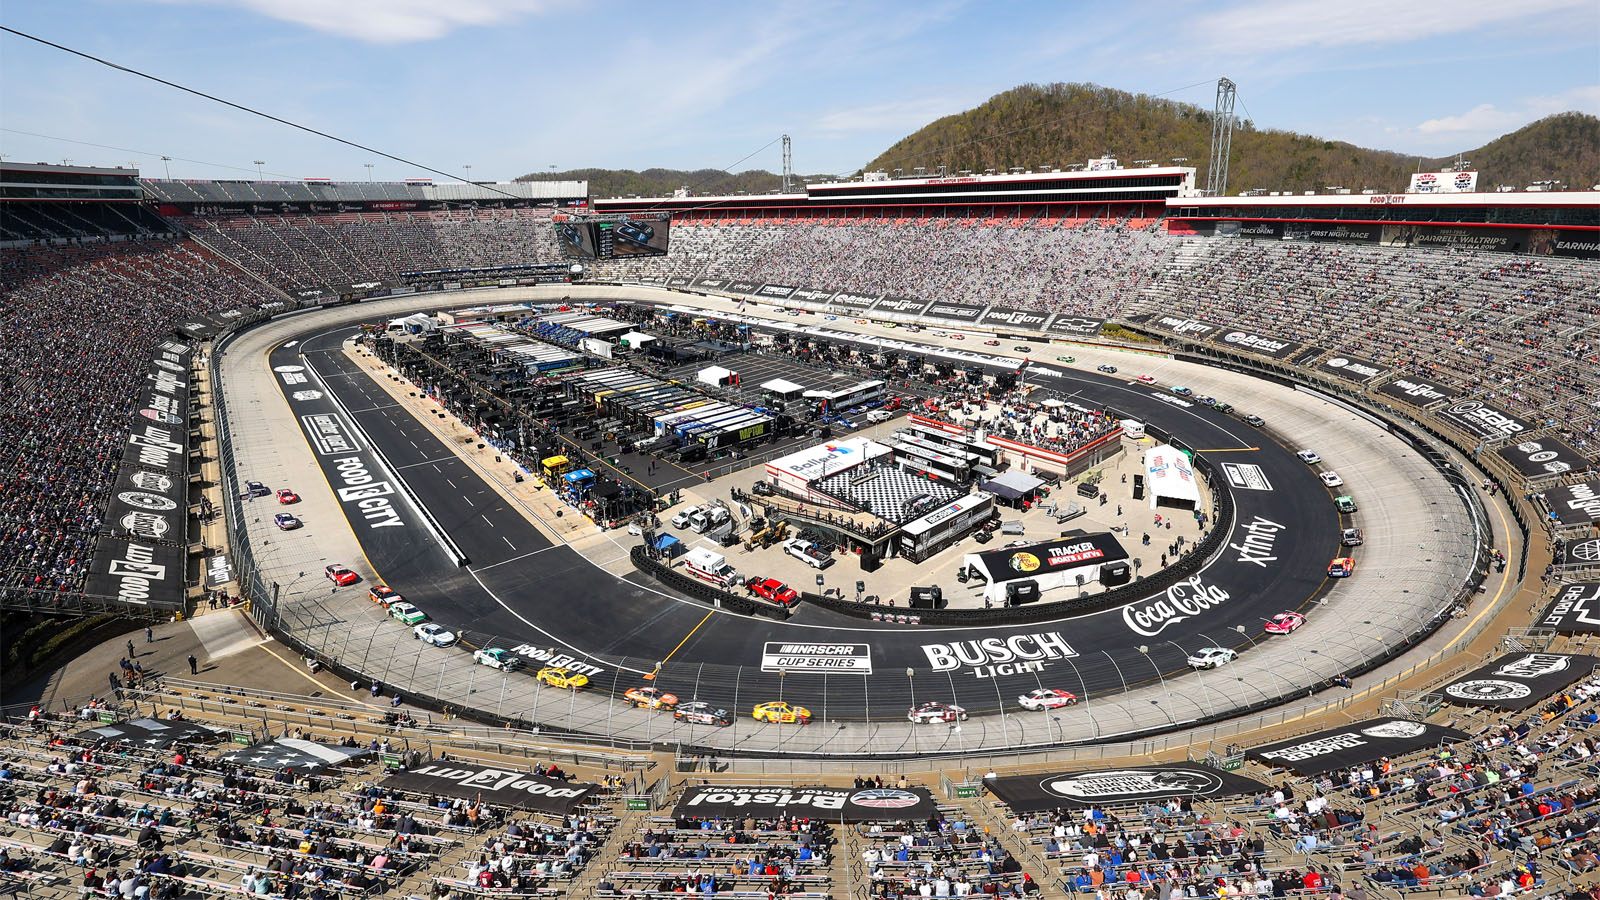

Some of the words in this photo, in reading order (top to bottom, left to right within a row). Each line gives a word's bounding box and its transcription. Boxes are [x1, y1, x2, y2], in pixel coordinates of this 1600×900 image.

[1418, 234, 1458, 243] DARRELL
[1459, 236, 1508, 245] WALTRIP'S
[846, 295, 876, 304] Bristol
[987, 312, 1008, 320] FOOD
[1022, 316, 1046, 324] CITY
[1052, 324, 1097, 334] CHEVROLET
[1192, 323, 1214, 333] CITY
[1244, 334, 1288, 350] Bristol
[1424, 389, 1446, 400] CITY
[1470, 408, 1524, 434] state
[144, 426, 171, 442] CITY
[739, 424, 764, 440] RAPTOR
[708, 436, 718, 448] 24
[139, 446, 169, 468] FOOD
[790, 453, 838, 472] Ballad
[334, 456, 372, 484] FOOD
[358, 498, 404, 528] CITY
[134, 512, 158, 536] BUSH'S
[928, 508, 954, 524] NASCAR
[1048, 542, 1095, 557] TRACKER
[1231, 516, 1286, 568] xfinity
[126, 543, 154, 564] CITY
[1052, 555, 1076, 564] BOATS
[1082, 550, 1100, 560] ATVs
[118, 576, 150, 605] FOOD
[1543, 586, 1585, 626] CHEVROLET
[798, 646, 854, 655] NASCAR
[920, 632, 1080, 672] BUSCH
[511, 644, 554, 662] FOOD
[566, 658, 604, 677] CITY
[776, 658, 801, 668] CUP
[804, 656, 855, 668] SERIES
[974, 660, 1046, 679] LIGHT
[1280, 740, 1368, 761] TRACKER
[407, 765, 474, 780] CITY
[510, 778, 587, 798] FOOD
[702, 786, 791, 796] Speedway
[1071, 778, 1150, 791] CHILDREN'S
[1081, 782, 1159, 796] SPEEDWAY
[687, 792, 846, 810] Bristol
[796, 789, 849, 798] Motor
